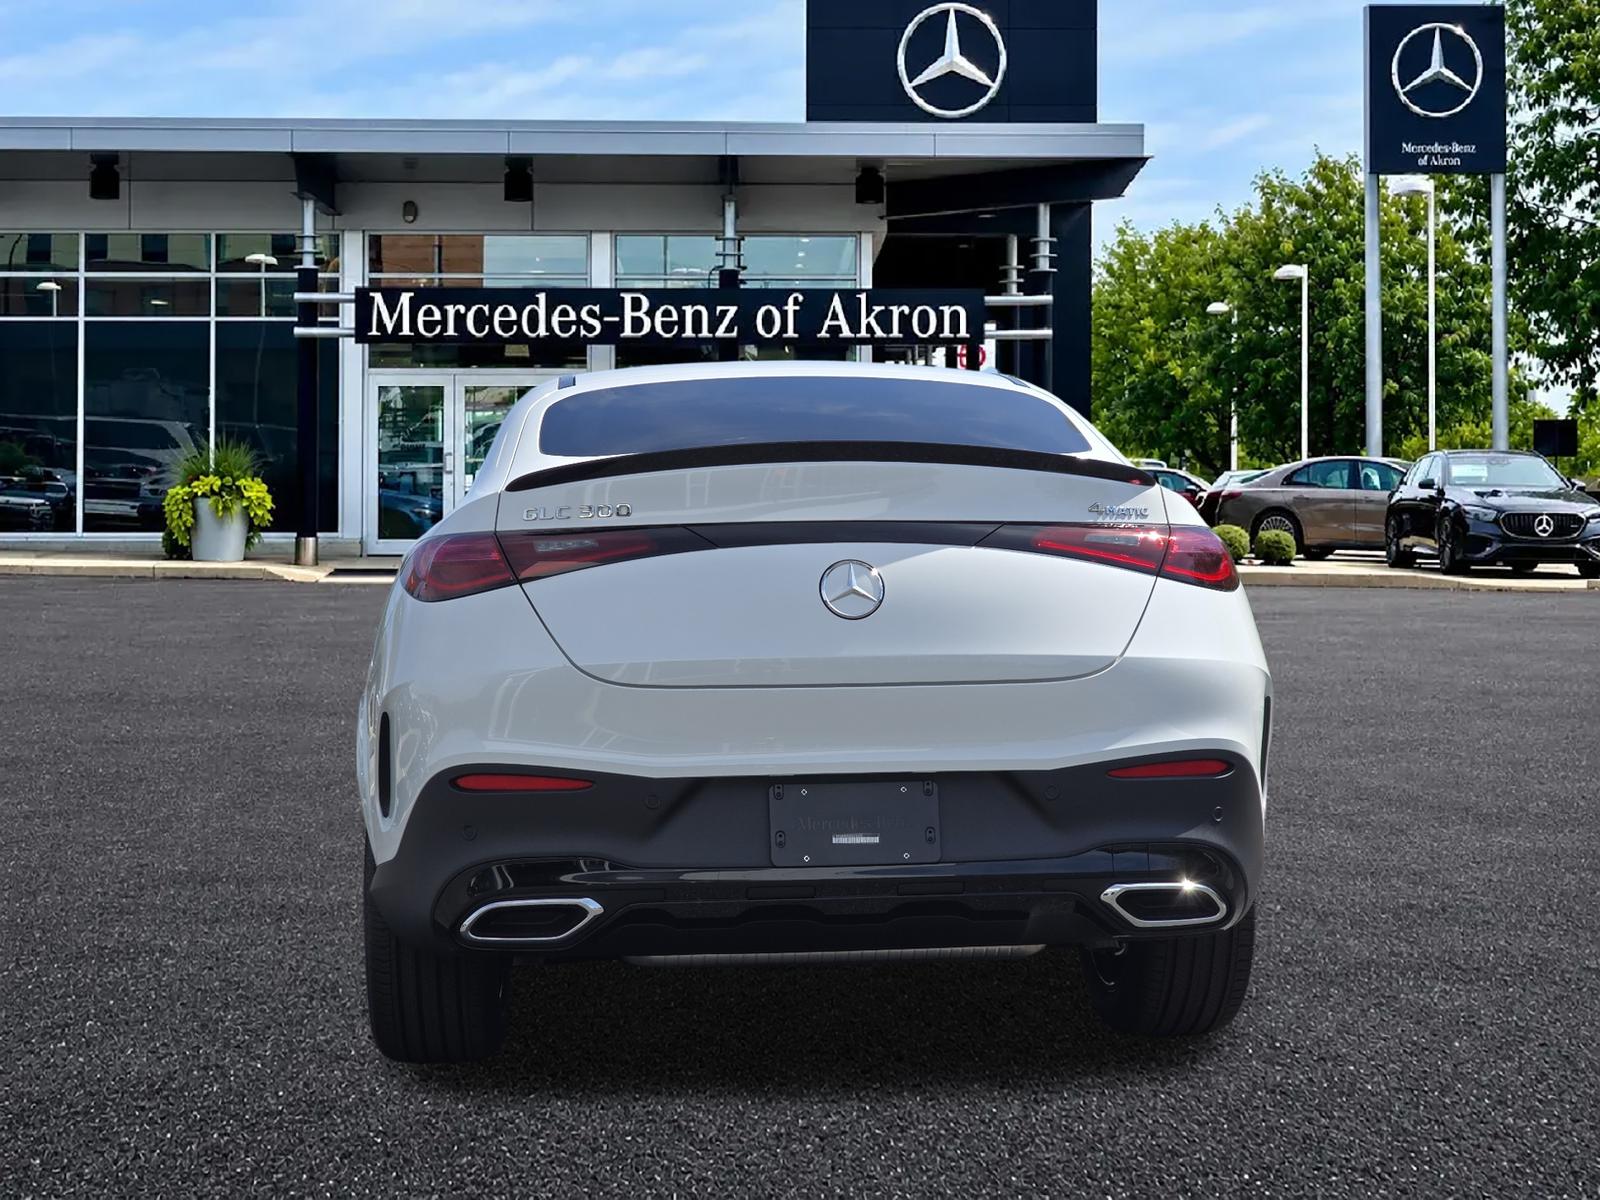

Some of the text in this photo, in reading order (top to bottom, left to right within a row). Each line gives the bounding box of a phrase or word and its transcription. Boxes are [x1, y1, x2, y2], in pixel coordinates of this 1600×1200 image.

[1401, 142, 1477, 154] Mercedes-Benz
[1417, 154, 1461, 166] of Akron
[367, 291, 971, 339] Mercedes-Benz of Akron
[522, 503, 632, 521] GLC 300
